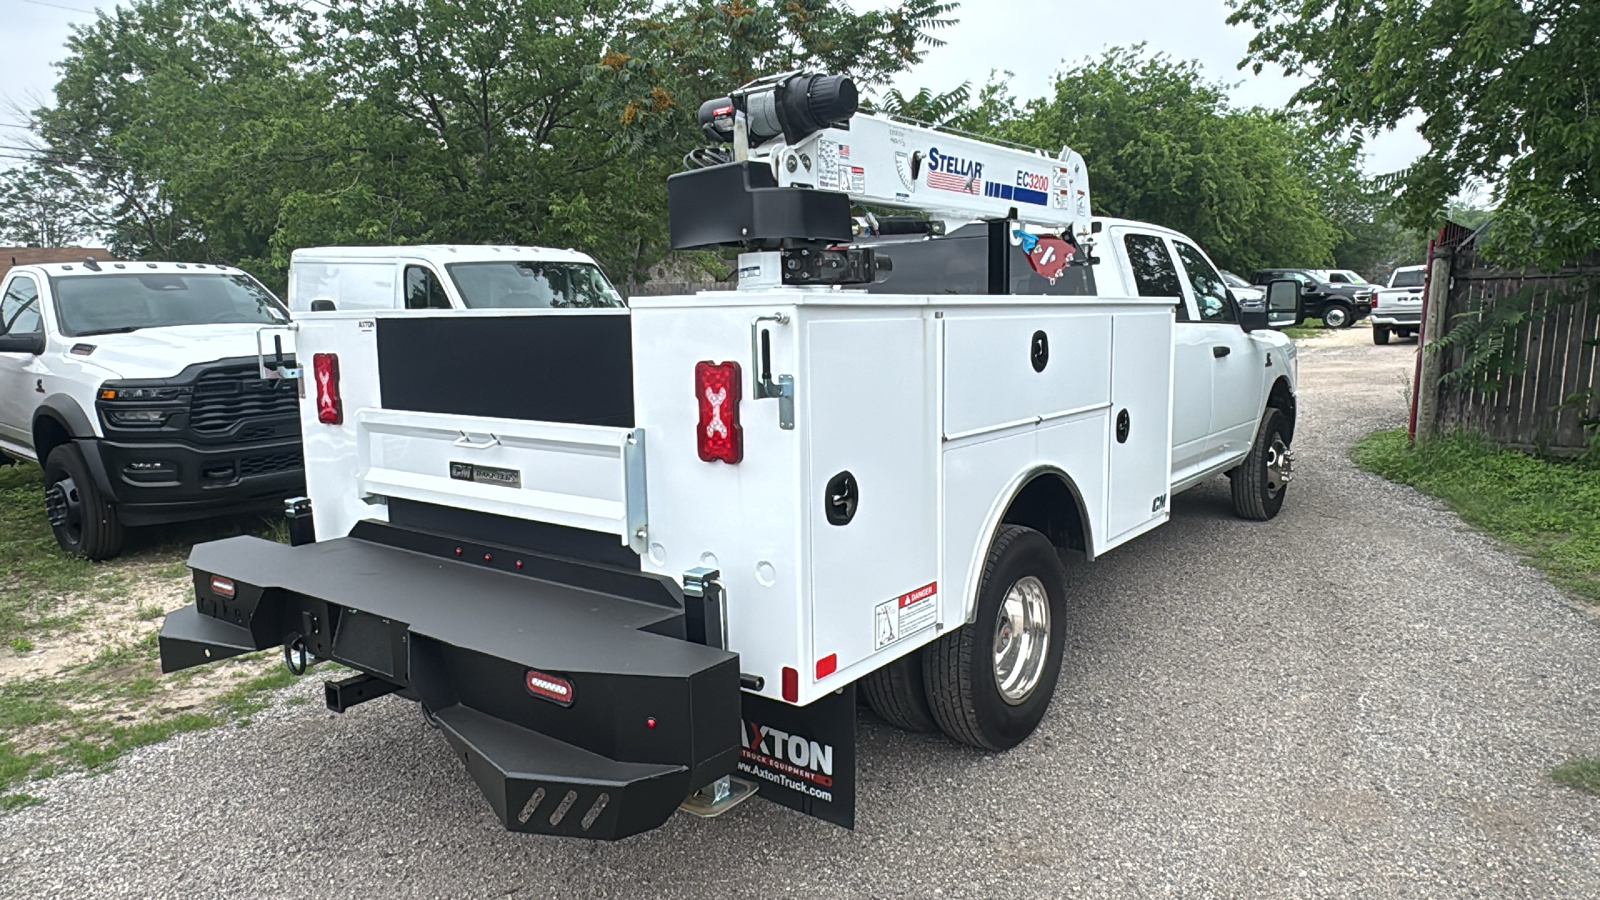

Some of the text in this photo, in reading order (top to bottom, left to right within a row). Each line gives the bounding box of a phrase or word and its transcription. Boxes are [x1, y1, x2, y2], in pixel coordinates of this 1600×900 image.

[928, 147, 982, 179] STELLAR
[1017, 170, 1049, 192] EC3200
[358, 320, 375, 328] AXTON
[911, 586, 933, 602] DANGER
[742, 750, 815, 780] TRUCK EQUIPMENT
